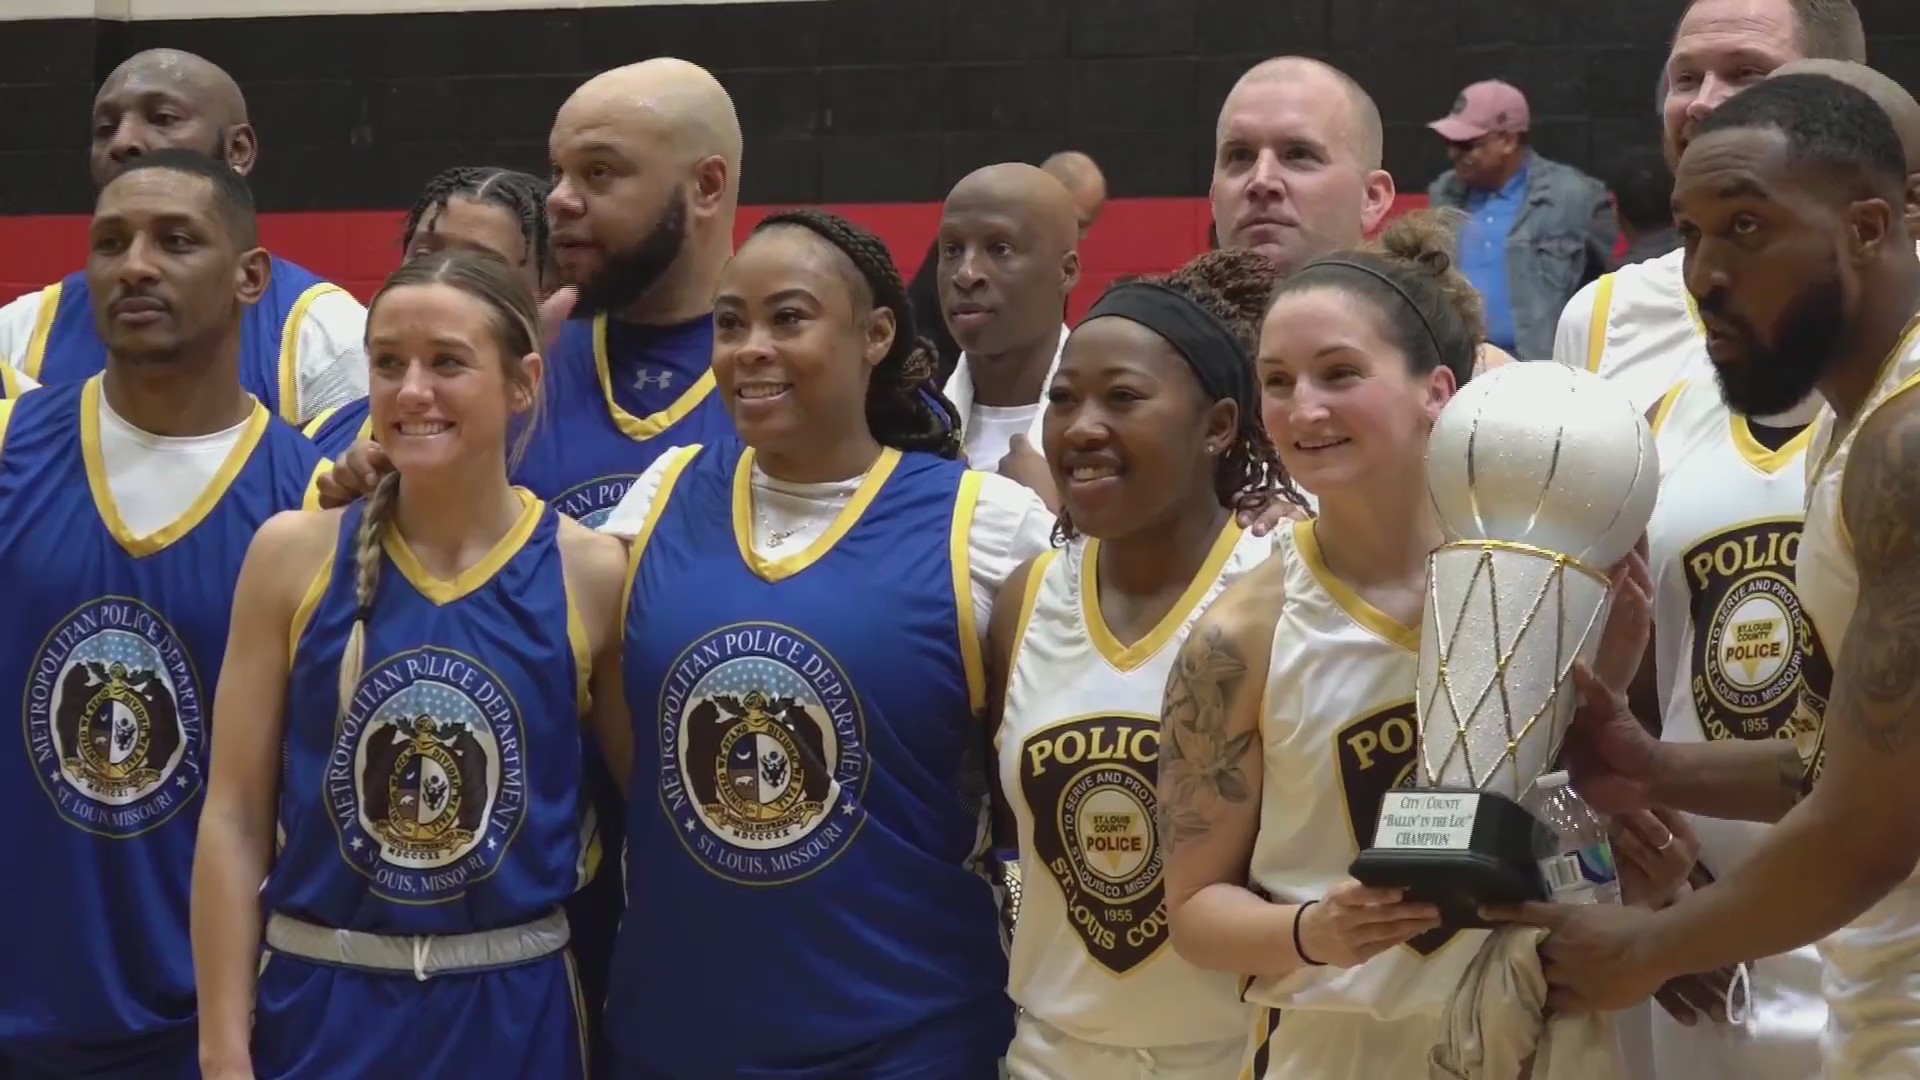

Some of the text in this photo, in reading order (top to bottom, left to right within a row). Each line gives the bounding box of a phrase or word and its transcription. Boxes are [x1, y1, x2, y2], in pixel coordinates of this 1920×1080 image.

[1719, 585, 1747, 624] SERVE
[1748, 579, 1771, 592] AND
[1726, 641, 1781, 662] POLICE
[1737, 632, 1770, 643] COUNTY
[31, 610, 98, 764] METROPOLITAN
[100, 604, 161, 640] POLICE
[1762, 650, 1802, 701] MISSOURI
[662, 638, 720, 813] METROPOLITAN
[725, 630, 805, 664] POLICE
[1741, 716, 1769, 734] 1955
[330, 654, 522, 835] METROPOLITAN POLICE DEPARTMENT
[1096, 771, 1122, 784] AND
[1065, 776, 1095, 812] SERVE
[111, 791, 173, 828] MISSOURI
[1065, 814, 1074, 832] TO
[1094, 824, 1128, 833] COUNTY
[1396, 832, 1450, 846] CHAMPION
[697, 822, 843, 875] ST. LOUIS, MISSOURI
[1086, 836, 1142, 852] POLICE
[1051, 856, 1073, 893] ST.
[1103, 907, 1133, 923] 1955
